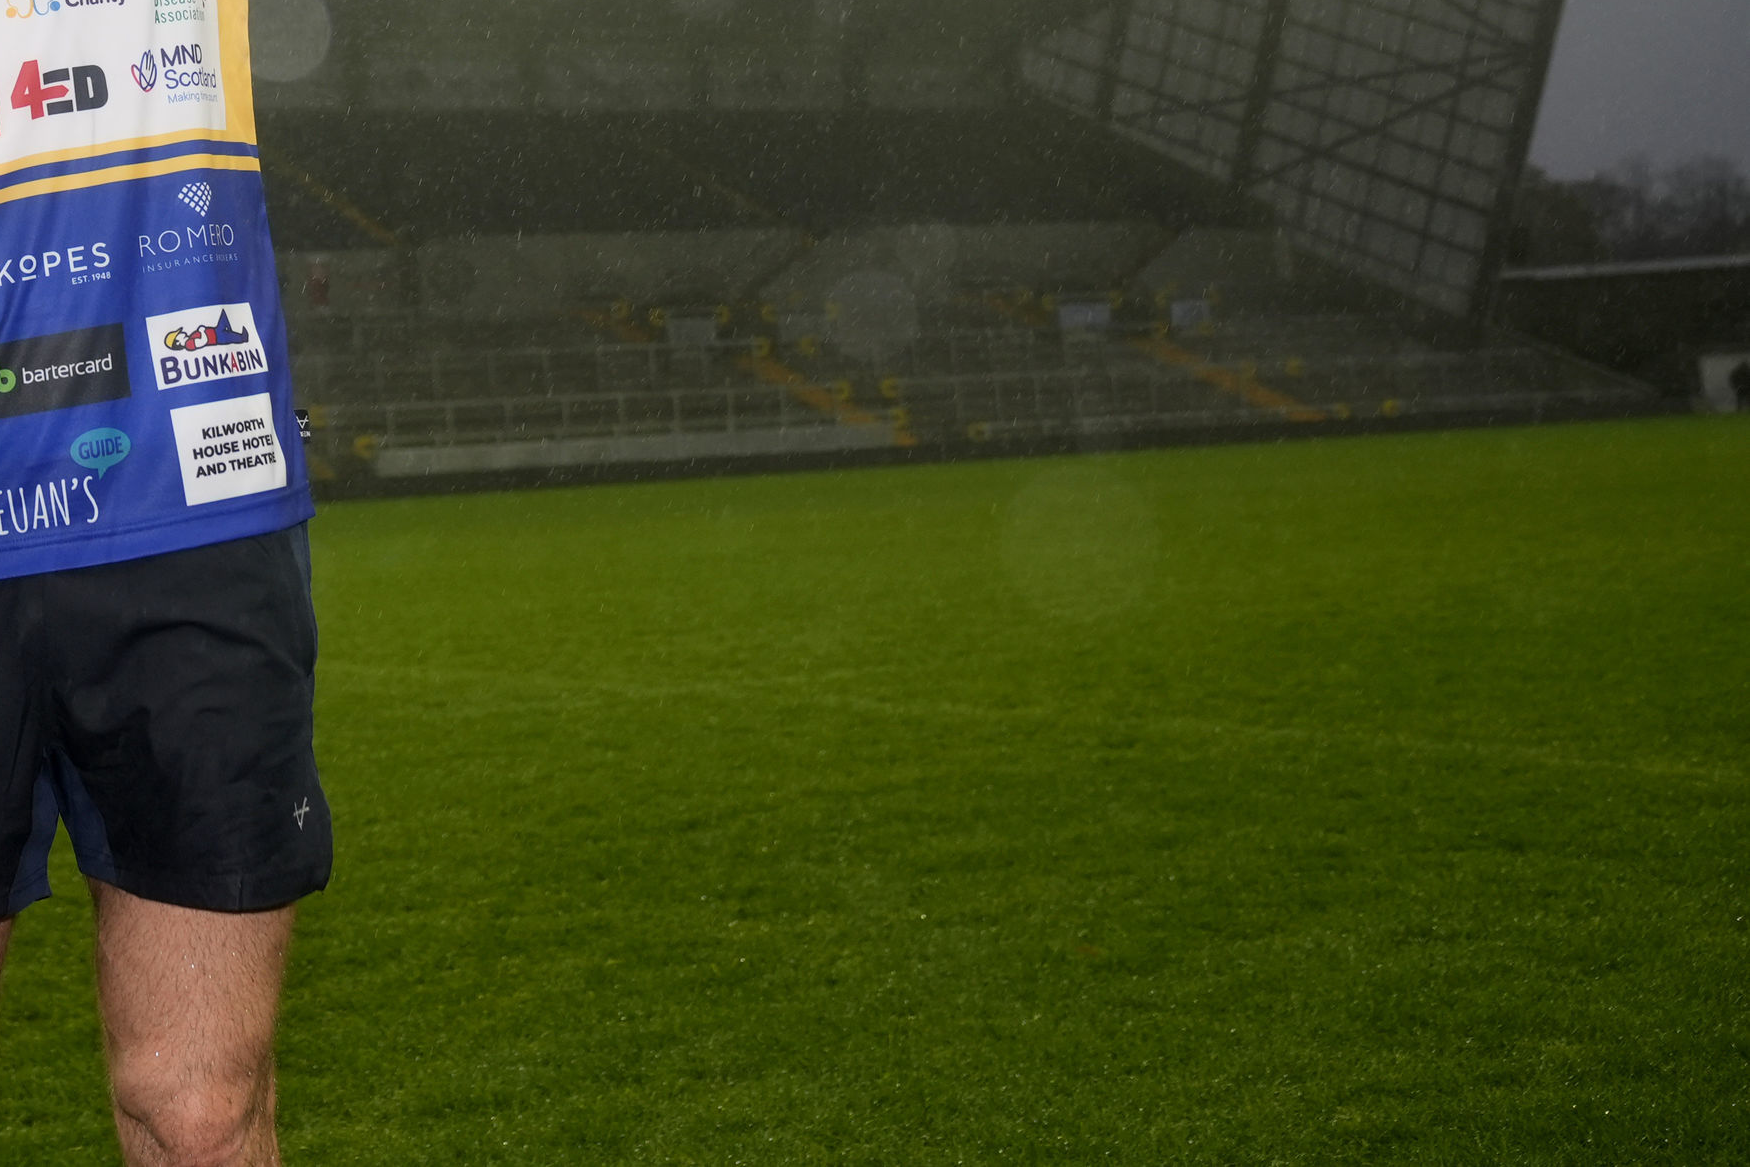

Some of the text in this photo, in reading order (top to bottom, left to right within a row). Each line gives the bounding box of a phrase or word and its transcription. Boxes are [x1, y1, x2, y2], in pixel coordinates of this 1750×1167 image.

[160, 43, 203, 69] MND
[164, 67, 217, 90] Scotland
[138, 224, 234, 258] ROMERO
[141, 254, 215, 274] INSURANCE
[71, 271, 111, 285] EST. 1948
[22, 354, 113, 385] bartercard
[201, 417, 265, 440] KILWORTH
[78, 435, 124, 460] GUIDE
[192, 441, 240, 460] HOUSE
[196, 462, 227, 479] AND
